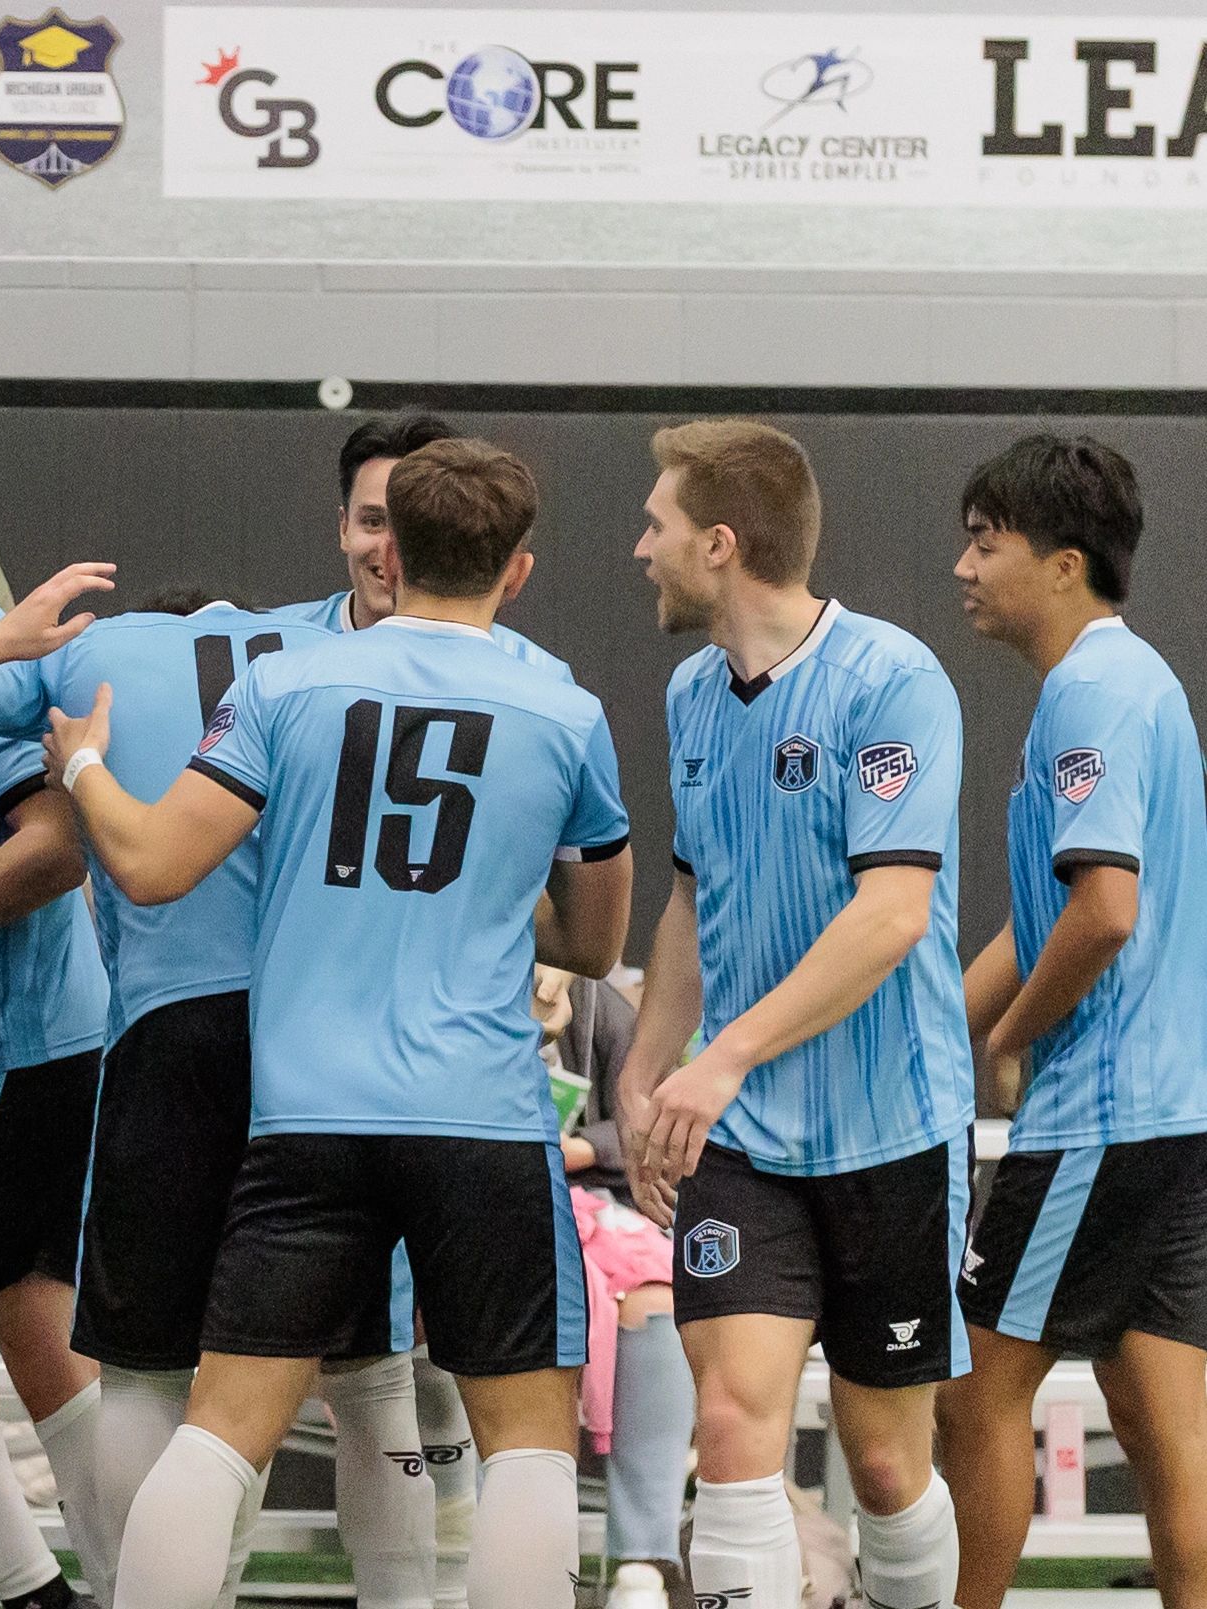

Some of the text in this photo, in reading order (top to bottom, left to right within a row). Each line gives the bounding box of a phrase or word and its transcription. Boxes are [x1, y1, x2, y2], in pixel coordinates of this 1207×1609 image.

[374, 44, 640, 142] CORE
[699, 135, 928, 159] LEGACY CENTER
[729, 161, 898, 181] SPORTS COMPLEX
[861, 753, 914, 790] UPSL
[1057, 758, 1102, 792] UPSL
[324, 698, 495, 895] 15
[694, 1228, 726, 1241] DETROIT
[886, 1340, 921, 1352] DIAZA
